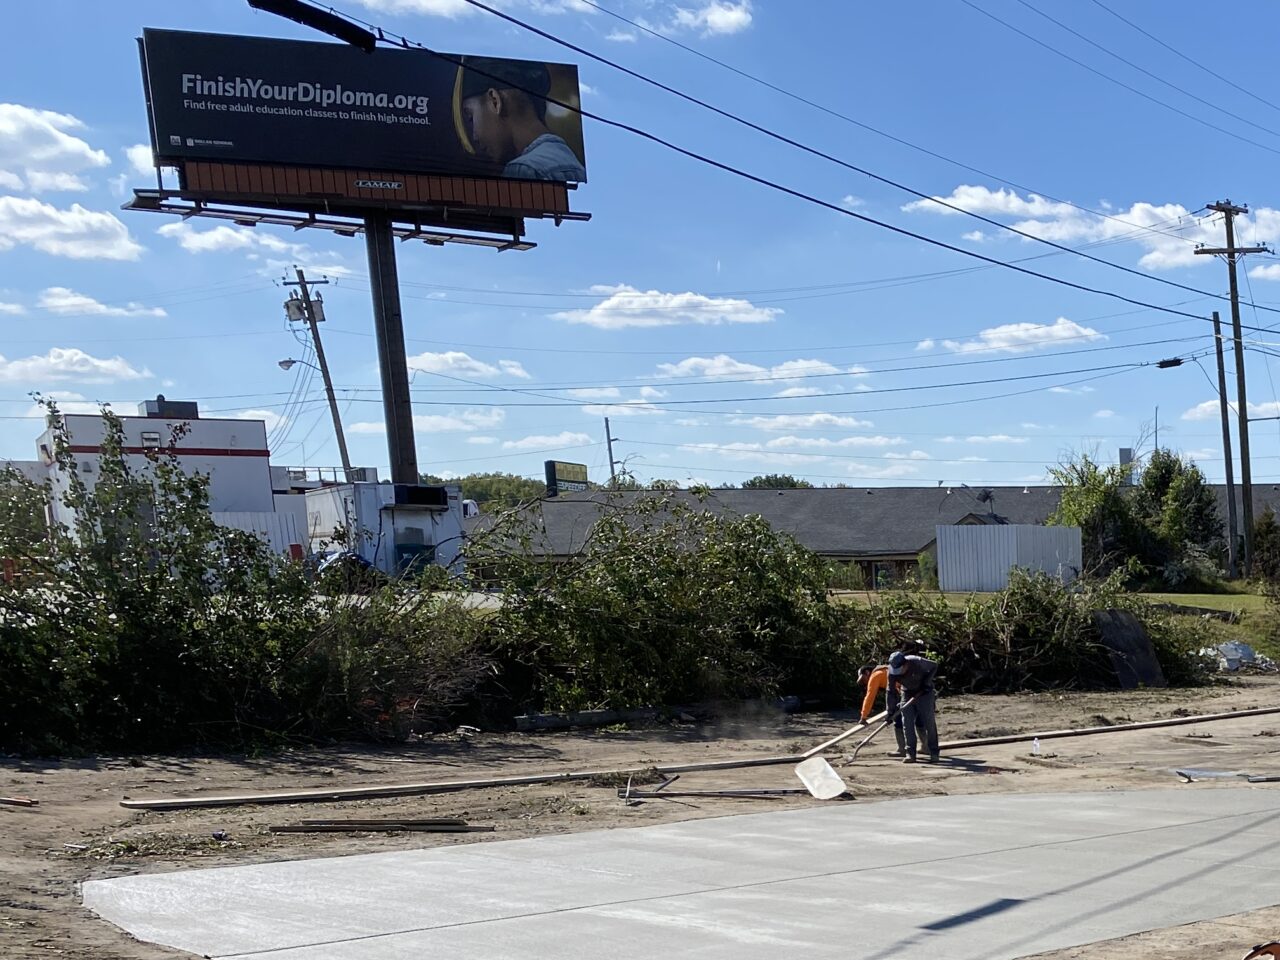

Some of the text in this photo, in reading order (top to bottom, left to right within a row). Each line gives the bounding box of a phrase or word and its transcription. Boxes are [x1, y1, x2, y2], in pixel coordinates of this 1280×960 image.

[182, 73, 430, 115] FinishYourDiploma.org
[183, 99, 431, 125] Find free adult education classes to finish high school.
[357, 180, 400, 189] LAMAR
